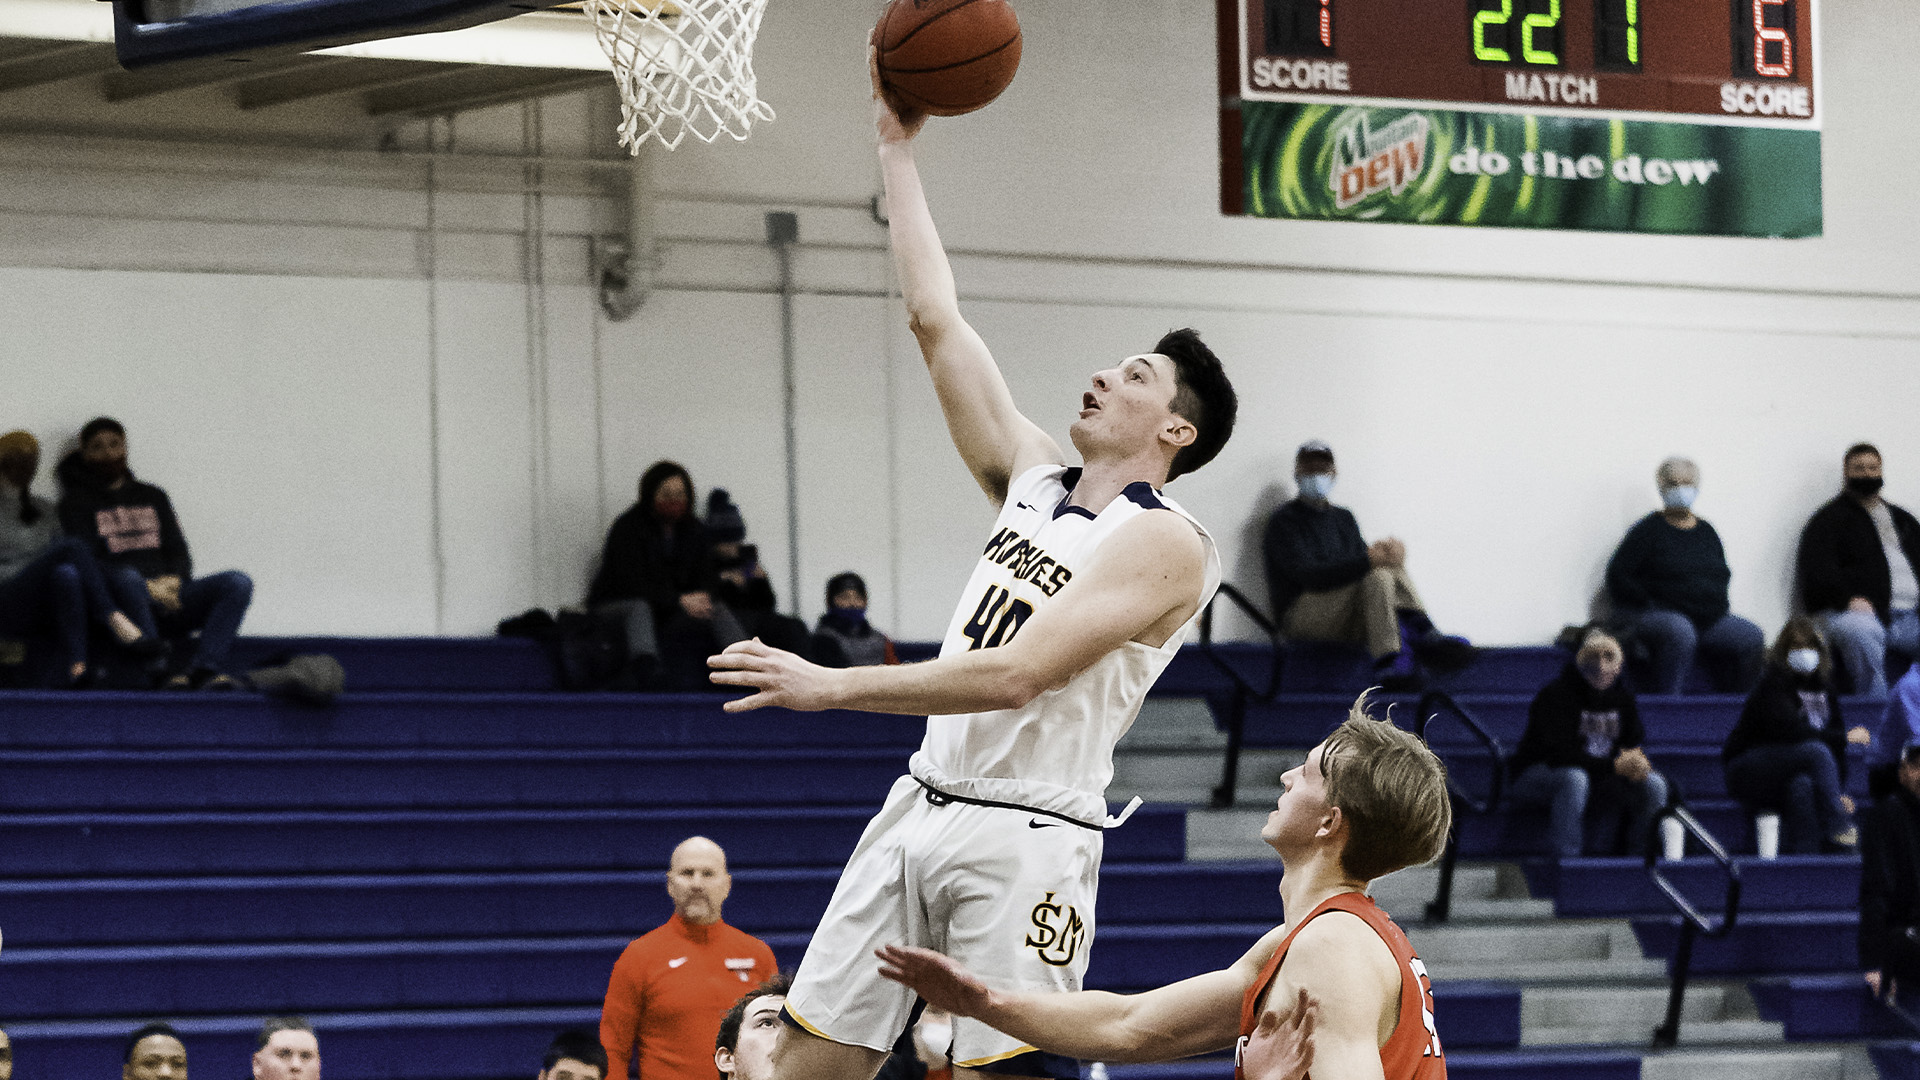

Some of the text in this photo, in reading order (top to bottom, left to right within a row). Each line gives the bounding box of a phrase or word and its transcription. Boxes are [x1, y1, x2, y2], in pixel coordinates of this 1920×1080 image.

[1473, 0, 1559, 64] 22
[1753, 0, 1792, 77] 6
[1253, 58, 1349, 90] SCORE
[1505, 72, 1598, 104] MATCH
[1720, 82, 1811, 116] SCORE
[1449, 146, 1720, 187] do the dew
